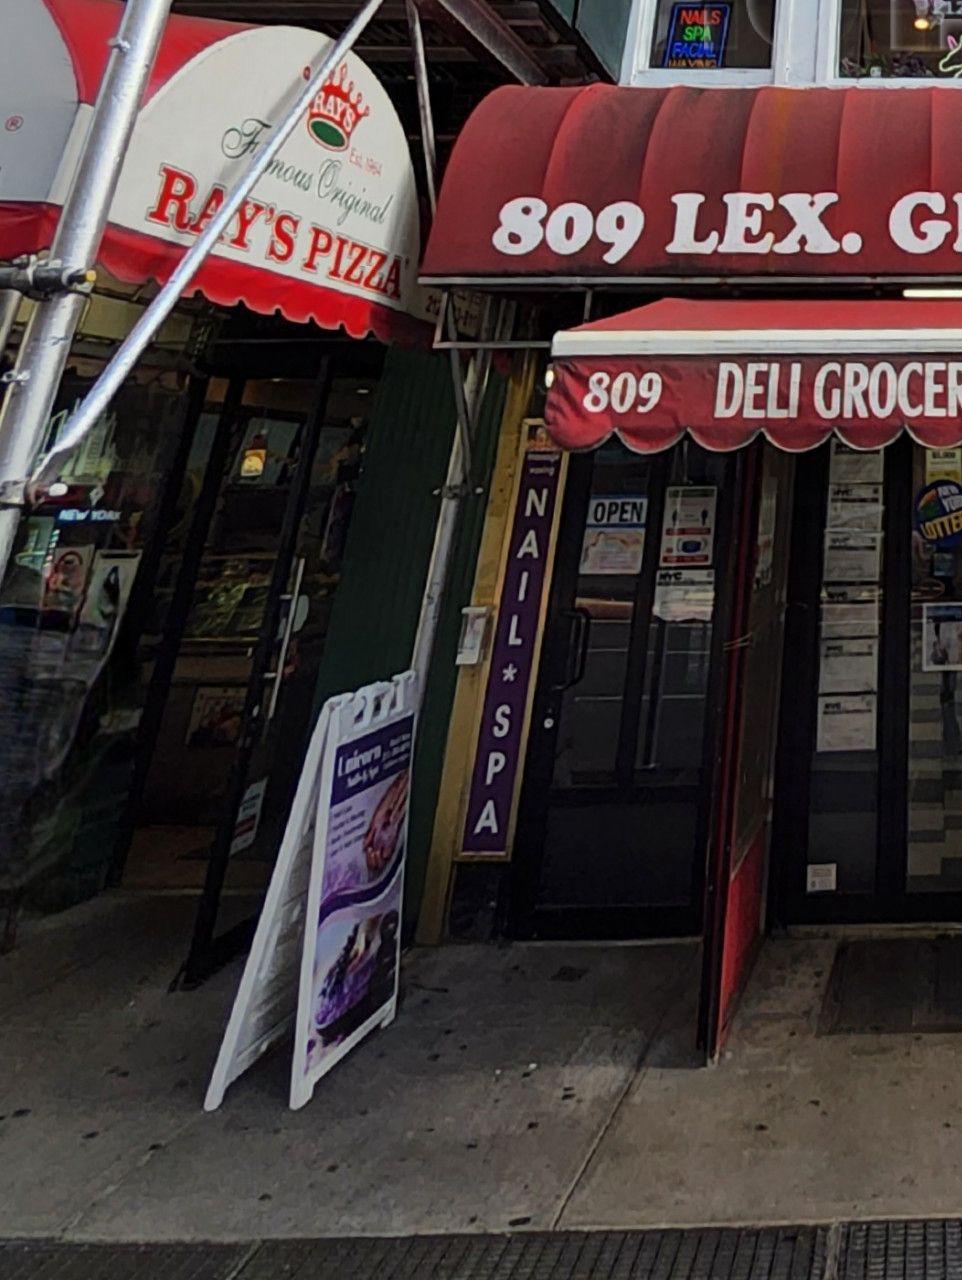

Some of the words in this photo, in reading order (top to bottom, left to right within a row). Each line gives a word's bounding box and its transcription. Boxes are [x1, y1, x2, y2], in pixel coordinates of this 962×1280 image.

[679, 9, 722, 25] NAILS
[682, 25, 713, 42] SPA
[671, 41, 717, 58] FACIAL
[222, 118, 312, 193] Fmous
[318, 158, 394, 226] Original
[492, 197, 645, 265] 809
[666, 192, 863, 254] LEX.
[303, 226, 402, 298] PIZZA
[582, 371, 662, 413] 809
[714, 362, 801, 419] DELI
[58, 508, 91, 521] NEW
[593, 501, 644, 524] OPEN
